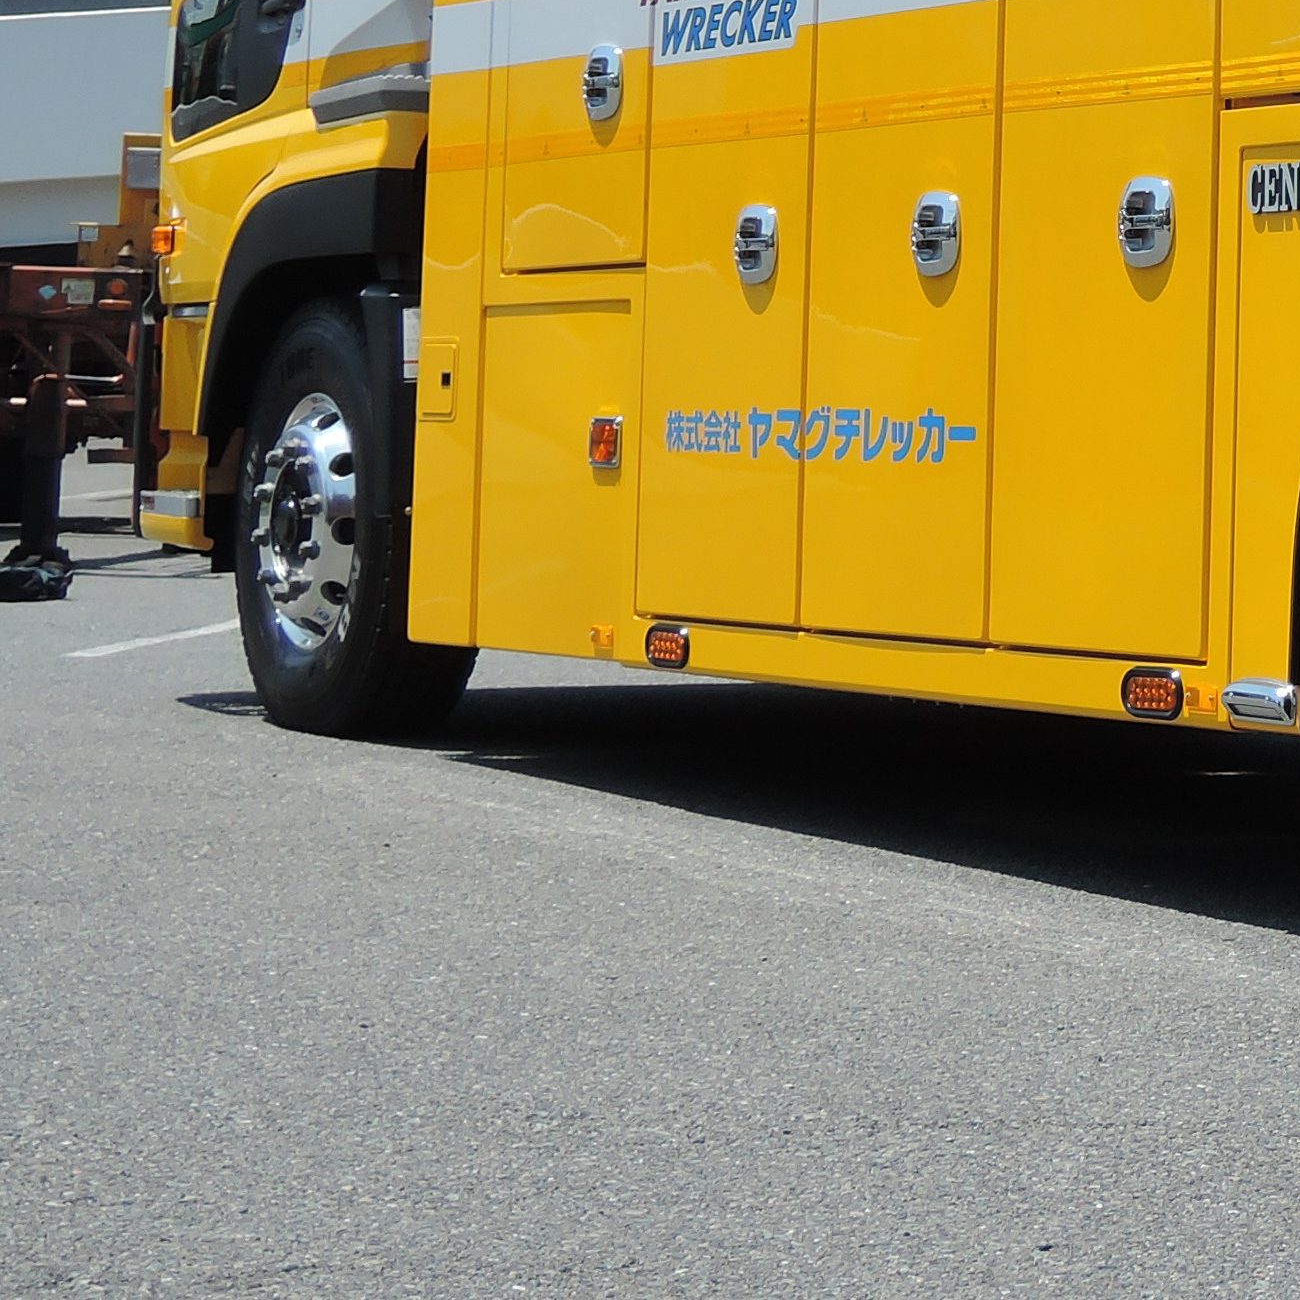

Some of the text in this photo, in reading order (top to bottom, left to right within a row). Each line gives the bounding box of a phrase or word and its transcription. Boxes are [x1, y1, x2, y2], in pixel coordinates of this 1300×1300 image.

[666, 406, 977, 463] 株式会社 ヤマグチレッカー
